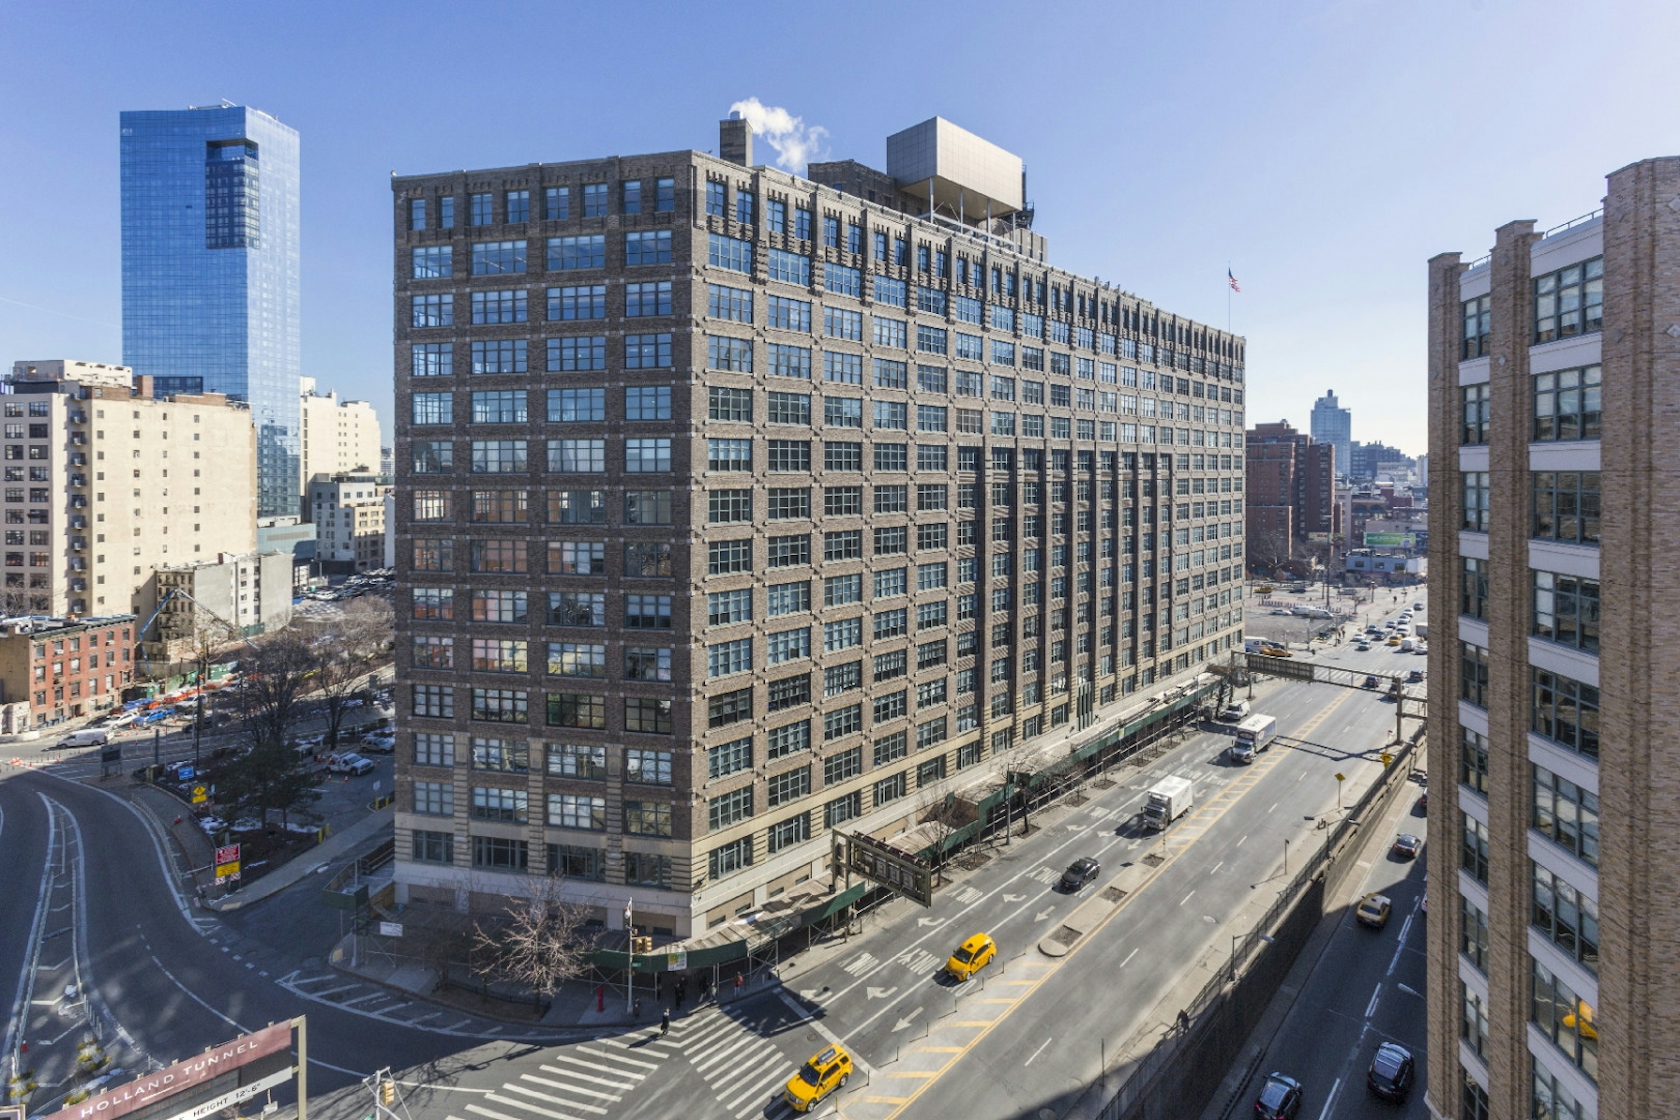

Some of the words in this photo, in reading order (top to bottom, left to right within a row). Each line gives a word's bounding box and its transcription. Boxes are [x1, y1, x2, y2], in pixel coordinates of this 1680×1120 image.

[897, 947, 942, 976] ONLY
[80, 1074, 174, 1119] HOLLAND
[183, 1041, 258, 1076] TUNNEL
[193, 1097, 229, 1117] HEIGHT
